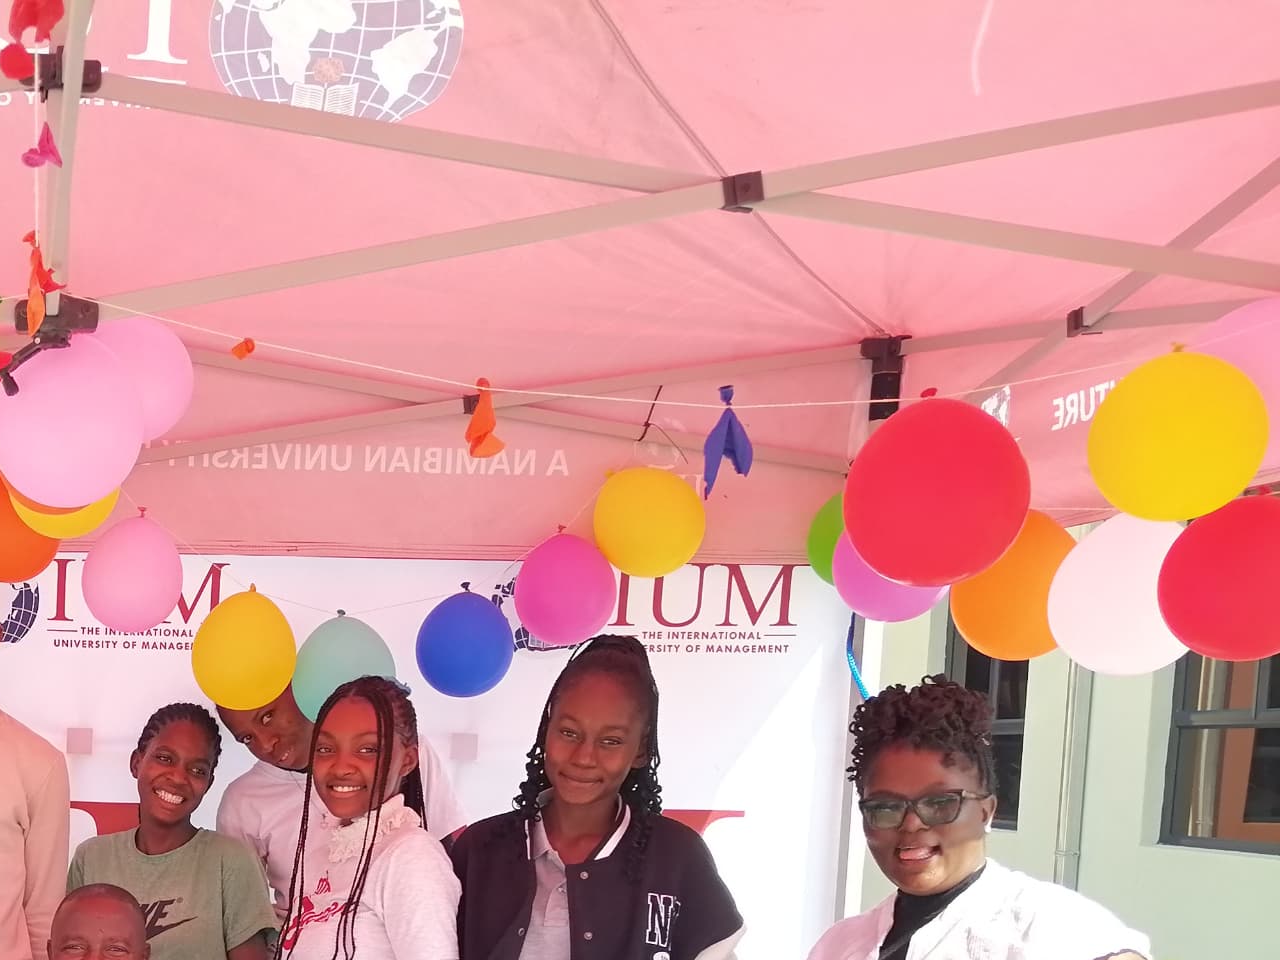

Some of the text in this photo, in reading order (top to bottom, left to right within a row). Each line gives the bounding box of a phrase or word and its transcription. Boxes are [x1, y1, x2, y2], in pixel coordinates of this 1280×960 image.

[47, 558, 231, 625] IM
[608, 563, 797, 628] IUM
[81, 626, 101, 636] THE
[642, 631, 762, 640] THE INTERNATIONAL
[53, 639, 194, 651] UNIVERSITY OF MANAGE
[685, 644, 701, 653] OF
[705, 644, 790, 653] MANAGEMENT
